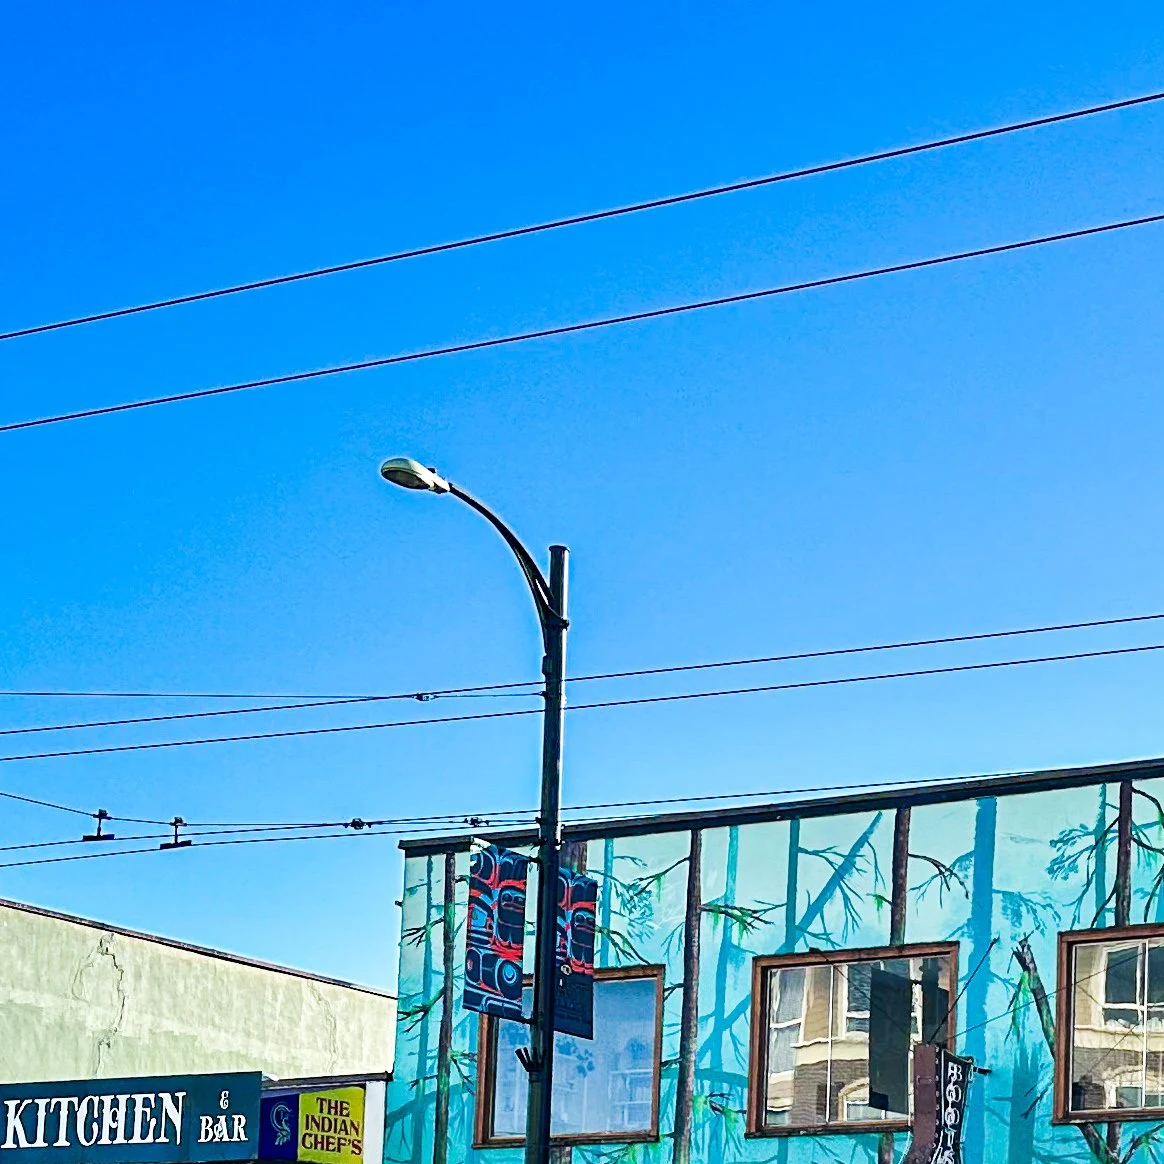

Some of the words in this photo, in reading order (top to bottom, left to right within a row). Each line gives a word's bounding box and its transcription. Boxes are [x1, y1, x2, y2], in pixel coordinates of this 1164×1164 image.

[316, 1096, 350, 1118] THE
[1, 1091, 187, 1149] KITCHEN
[197, 1114, 248, 1143] BAR
[305, 1113, 360, 1138] INDIAN
[301, 1132, 363, 1156] CHEF'S
